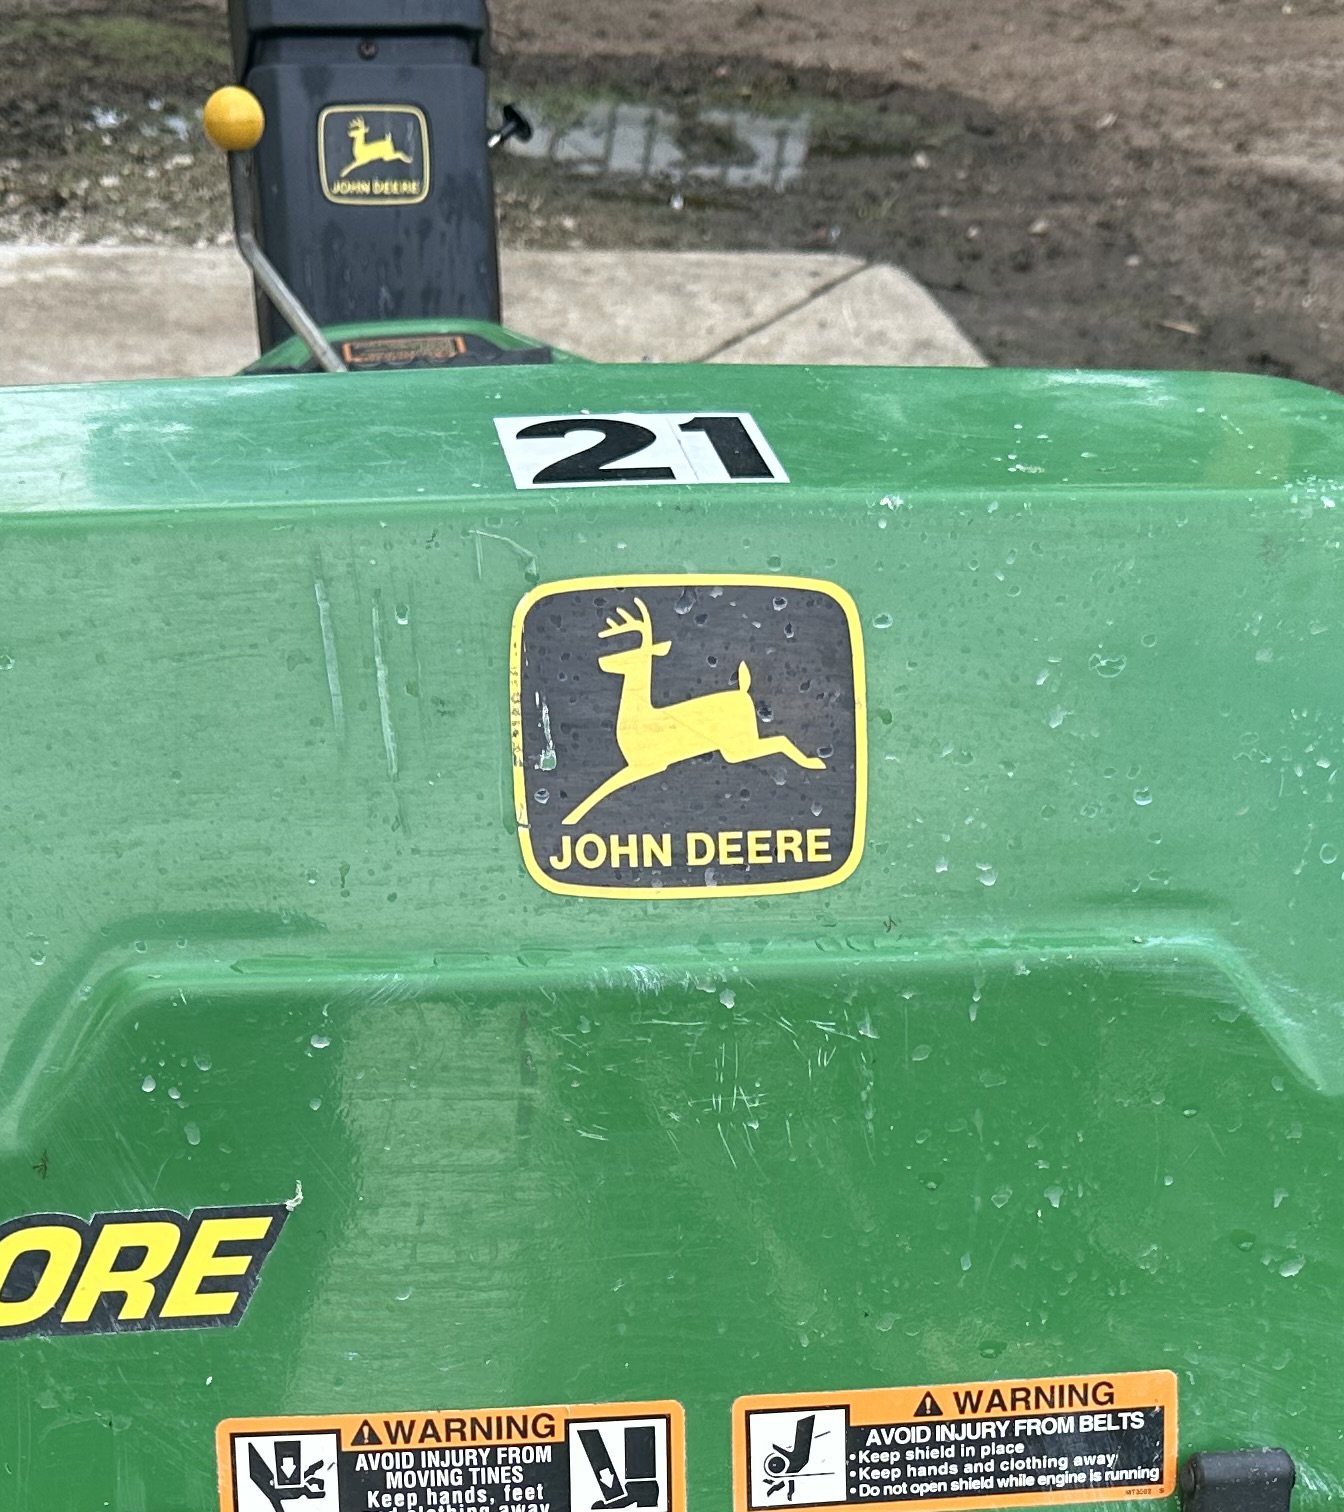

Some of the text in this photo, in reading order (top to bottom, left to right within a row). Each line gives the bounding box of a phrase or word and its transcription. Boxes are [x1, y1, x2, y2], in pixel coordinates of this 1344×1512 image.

[331, 180, 420, 195] JOHN DEERE
[515, 417, 775, 484] 21
[550, 828, 832, 871] JOHN DEERE
[953, 1381, 1115, 1415] WARNING
[383, 1412, 556, 1445] WARNING
[865, 1411, 1145, 1446] AVOID INJURY FROM BELTS
[355, 1445, 552, 1471] AVOID INJURY FROM
[858, 1441, 1025, 1465] Keep shield in place
[858, 1453, 1116, 1481] Keep hands and clothing away
[385, 1465, 524, 1490] MOVING TINES
[858, 1465, 1160, 1497] Do not open shield while engine is running
[367, 1483, 544, 1510] Keep hands, feet
